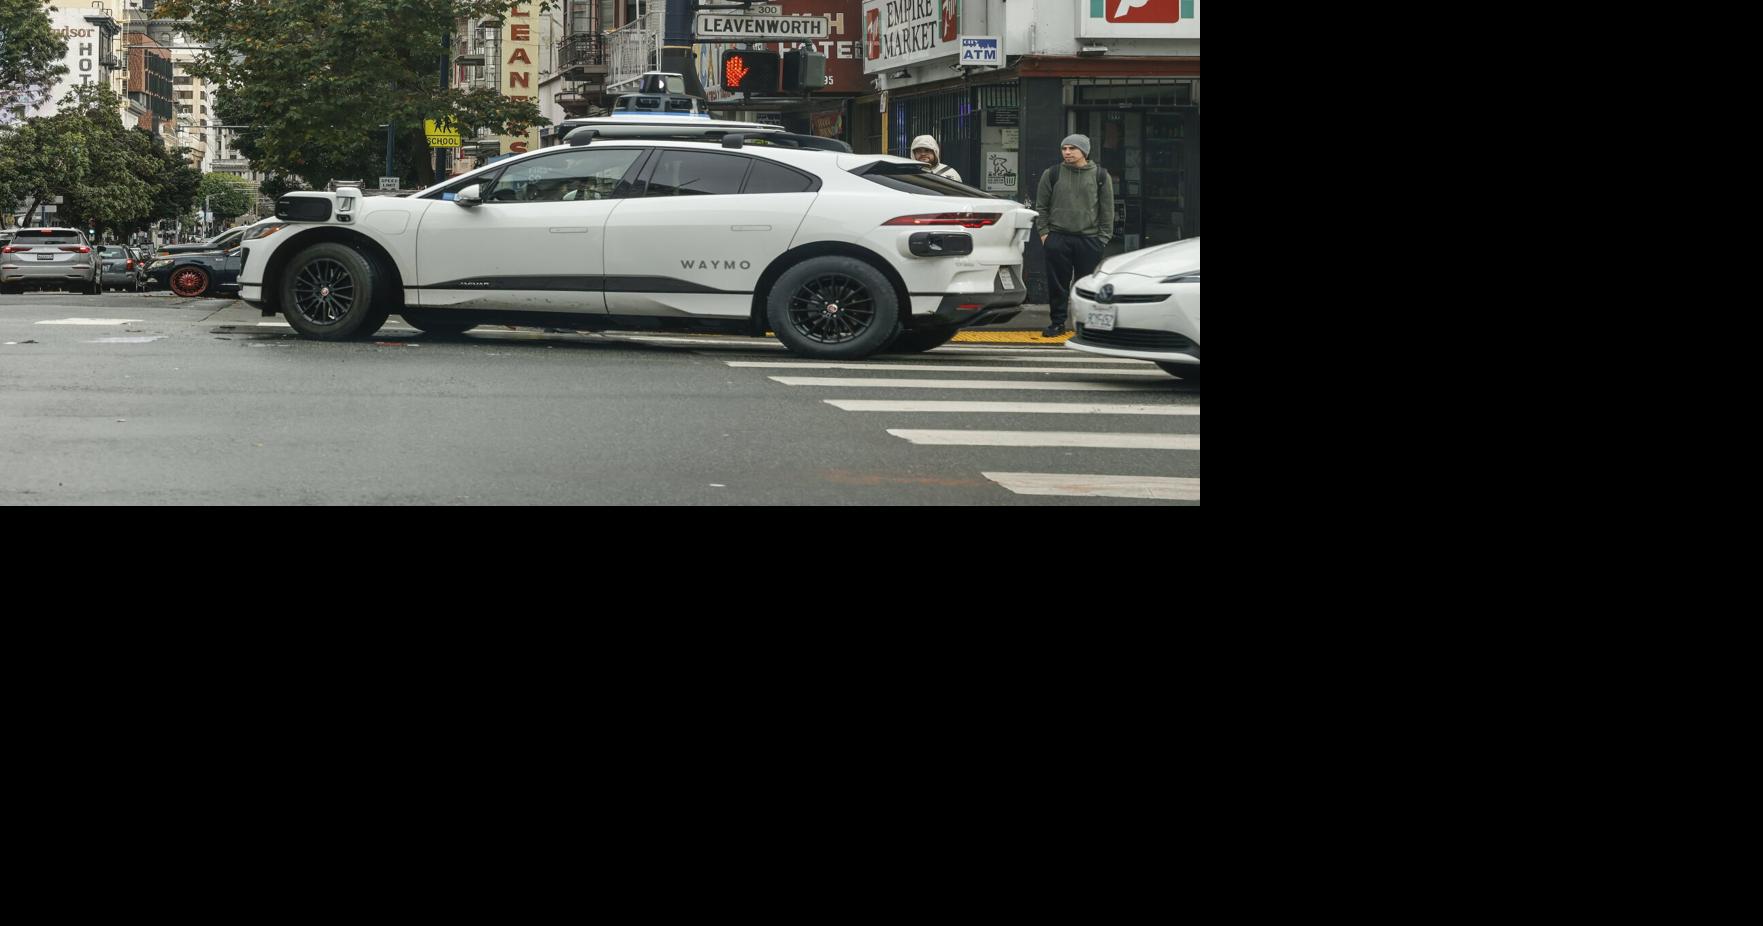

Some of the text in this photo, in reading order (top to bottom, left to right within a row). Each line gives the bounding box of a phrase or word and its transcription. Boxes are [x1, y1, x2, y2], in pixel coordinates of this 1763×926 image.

[758, 6, 777, 14] 300
[886, 0, 933, 28] EMPIRE
[704, 18, 821, 34] LEAVENWORTH
[883, 20, 938, 59] MARKET
[963, 49, 996, 59] ATM
[507, 6, 532, 153] LEANS
[427, 137, 459, 145] SCHOOL
[680, 260, 751, 270] WAYMO
